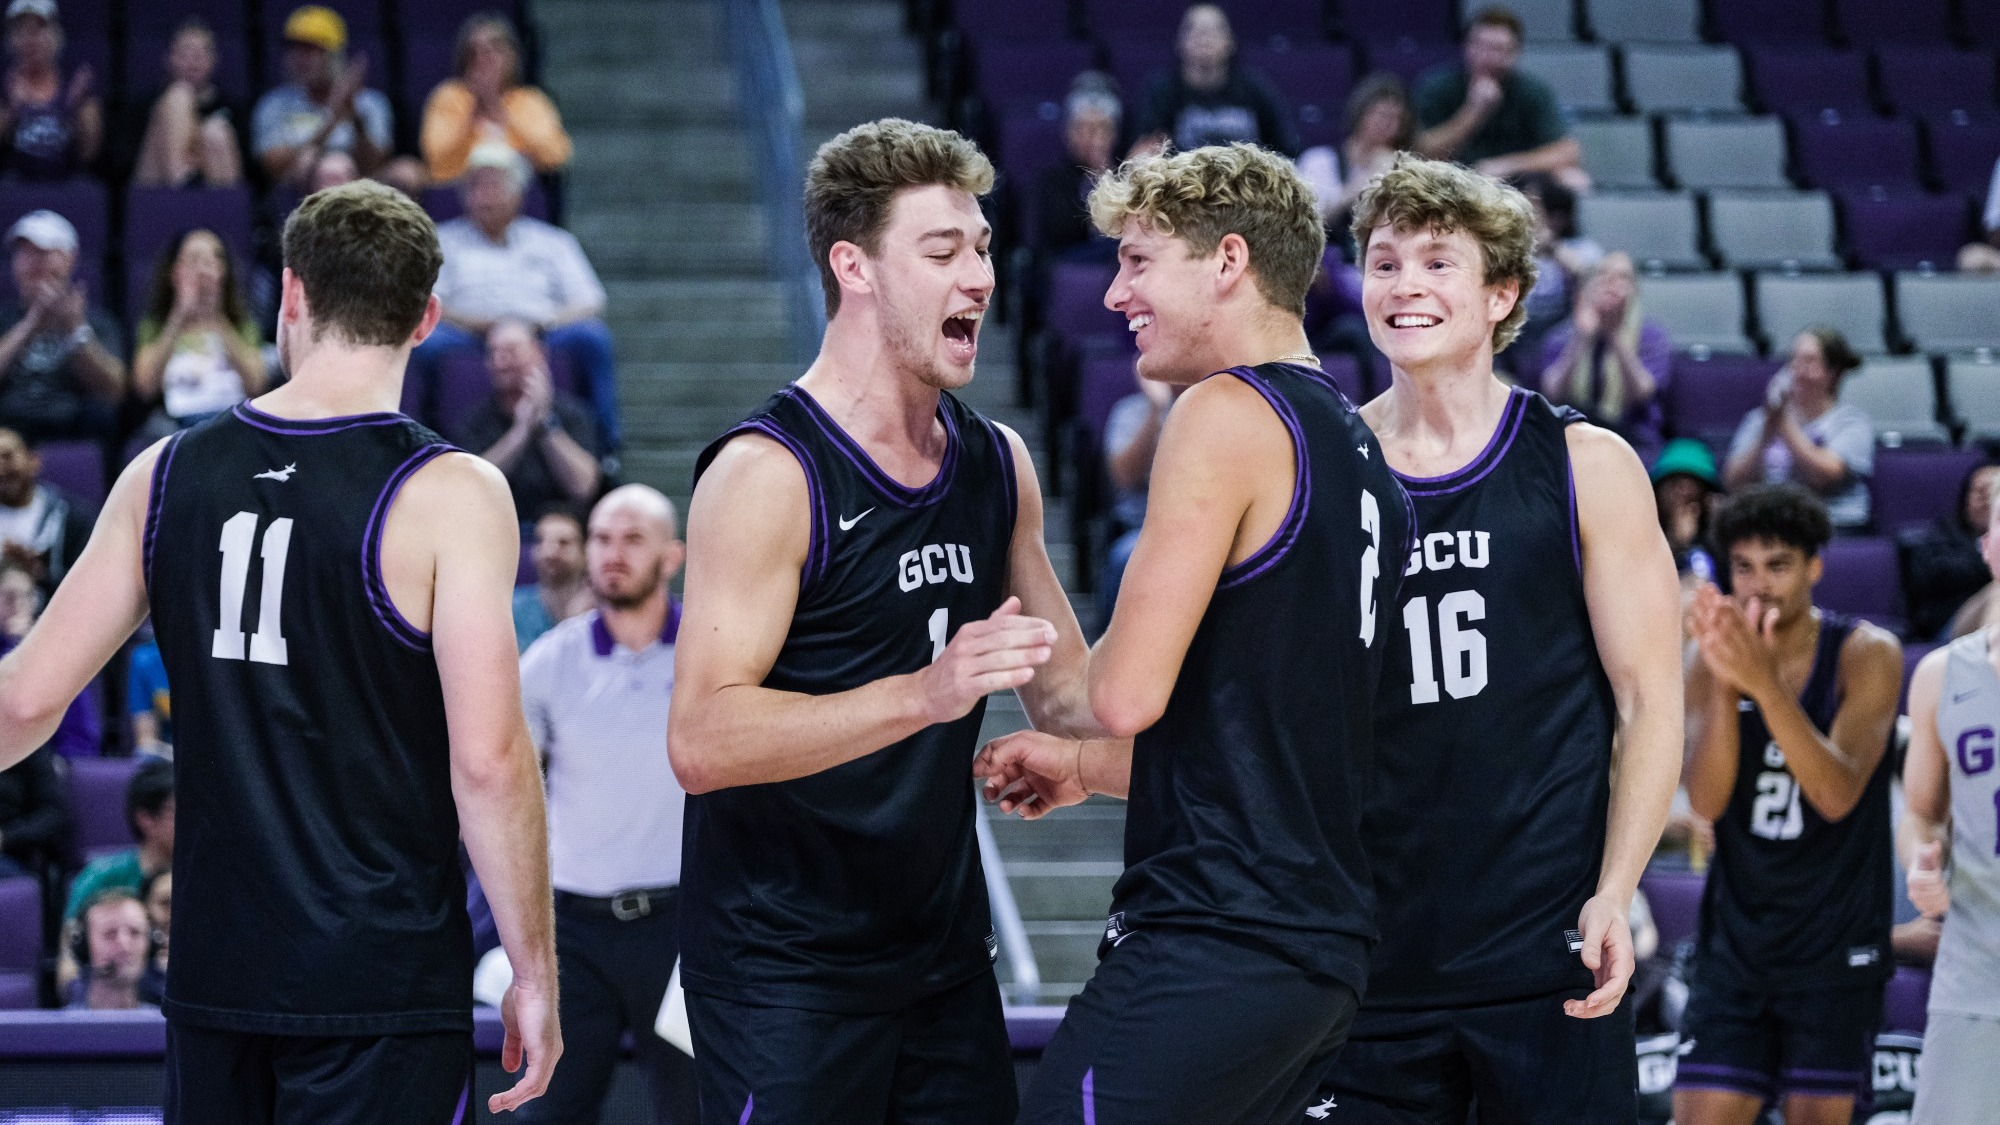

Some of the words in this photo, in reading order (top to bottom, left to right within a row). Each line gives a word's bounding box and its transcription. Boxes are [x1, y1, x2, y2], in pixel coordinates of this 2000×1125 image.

[212, 511, 294, 665] 11
[899, 543, 974, 592] GCU
[1403, 589, 1488, 704] 16
